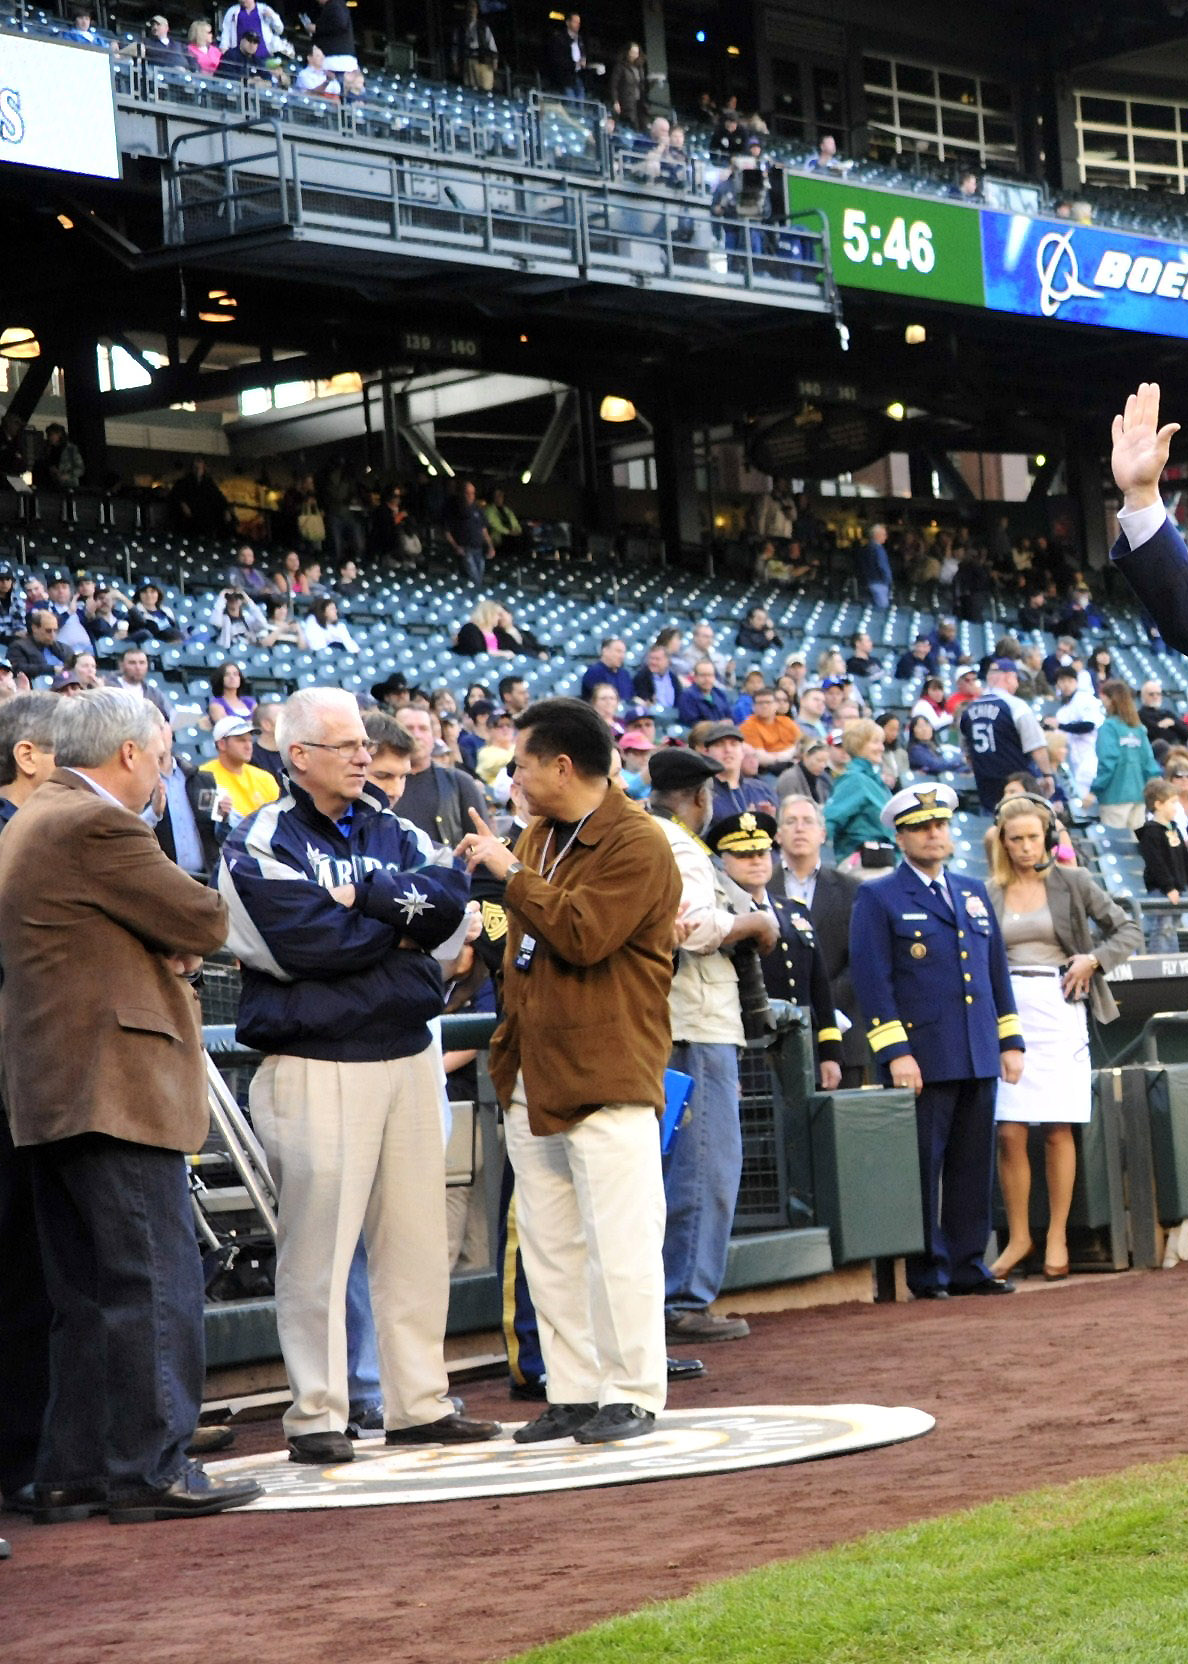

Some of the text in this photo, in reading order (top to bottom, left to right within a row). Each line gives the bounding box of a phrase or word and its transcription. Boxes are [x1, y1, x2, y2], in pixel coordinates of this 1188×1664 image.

[843, 207, 936, 274] 5:46
[972, 722, 997, 754] 51
[1162, 960, 1178, 975] FLY
